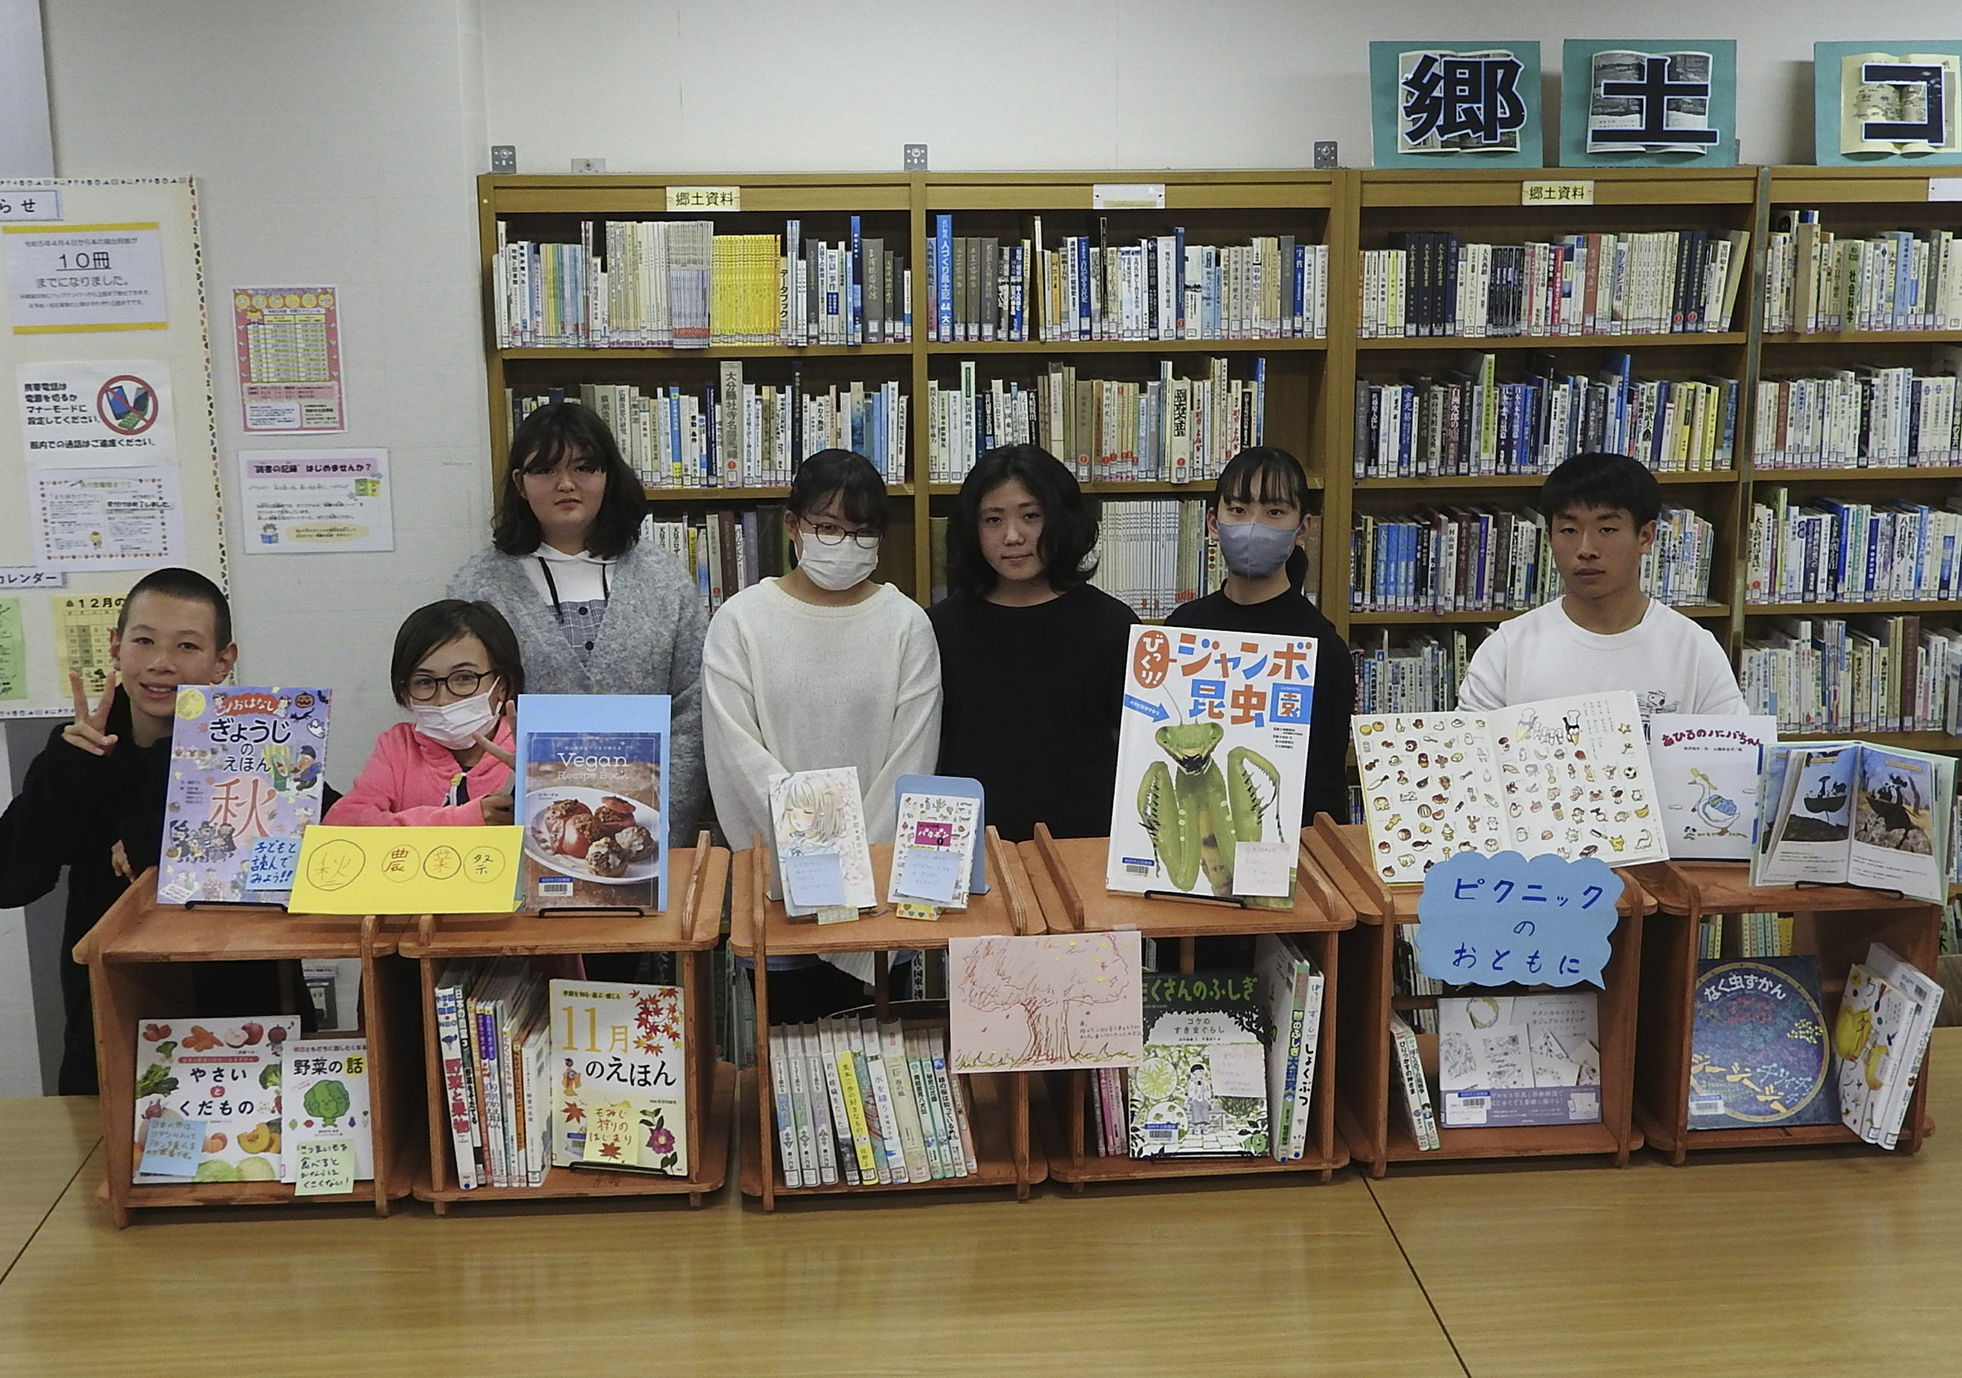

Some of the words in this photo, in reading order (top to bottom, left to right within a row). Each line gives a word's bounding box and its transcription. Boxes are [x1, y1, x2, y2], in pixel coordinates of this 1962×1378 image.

[1403, 54, 1527, 144] 郷
[1590, 56, 1719, 145] 土
[674, 191, 735, 206] 郷土資料
[1528, 185, 1585, 200] 郷土資料
[940, 240, 951, 301] 人づくり風土記
[36, 276, 129, 289] までになりました。
[780, 269, 789, 318] データブック
[24, 382, 67, 392] 携帯電話は
[25, 394, 78, 403] 電源を切るか
[26, 404, 88, 414] マナーモードに
[1140, 633, 1164, 685] びっくり!
[1178, 632, 1313, 681] ジャンボ
[232, 698, 275, 712] おはなし
[1189, 679, 1314, 728] 昆虫園
[210, 718, 291, 744] ぎょうじ
[240, 743, 254, 755] の
[223, 757, 272, 773] えほん
[557, 752, 630, 772] Vegan
[557, 771, 597, 781] Recipe
[600, 771, 629, 780] Book
[208, 777, 279, 839] 秋
[254, 840, 297, 855] 子どもと
[251, 855, 289, 871] 読んで
[250, 870, 293, 884] みよう!!
[1454, 877, 1603, 909] ピクニック
[1513, 920, 1536, 937] の
[1452, 942, 1581, 976] おともに
[1704, 972, 1787, 1003] なく虫ずかん
[561, 1005, 629, 1054] 11月
[1174, 1026, 1226, 1035] すきまぐらし
[460, 1038, 469, 1047] 3
[190, 1066, 247, 1083] やさい
[293, 1056, 364, 1076] 野菜の話
[586, 1055, 677, 1087] のえほん
[1299, 1042, 1315, 1106] しょくぶつ
[180, 1100, 255, 1117] くだもの
[596, 1107, 628, 1119] もみじ
[597, 1118, 629, 1132] 狩りの
[589, 1132, 632, 1145] はじまり
